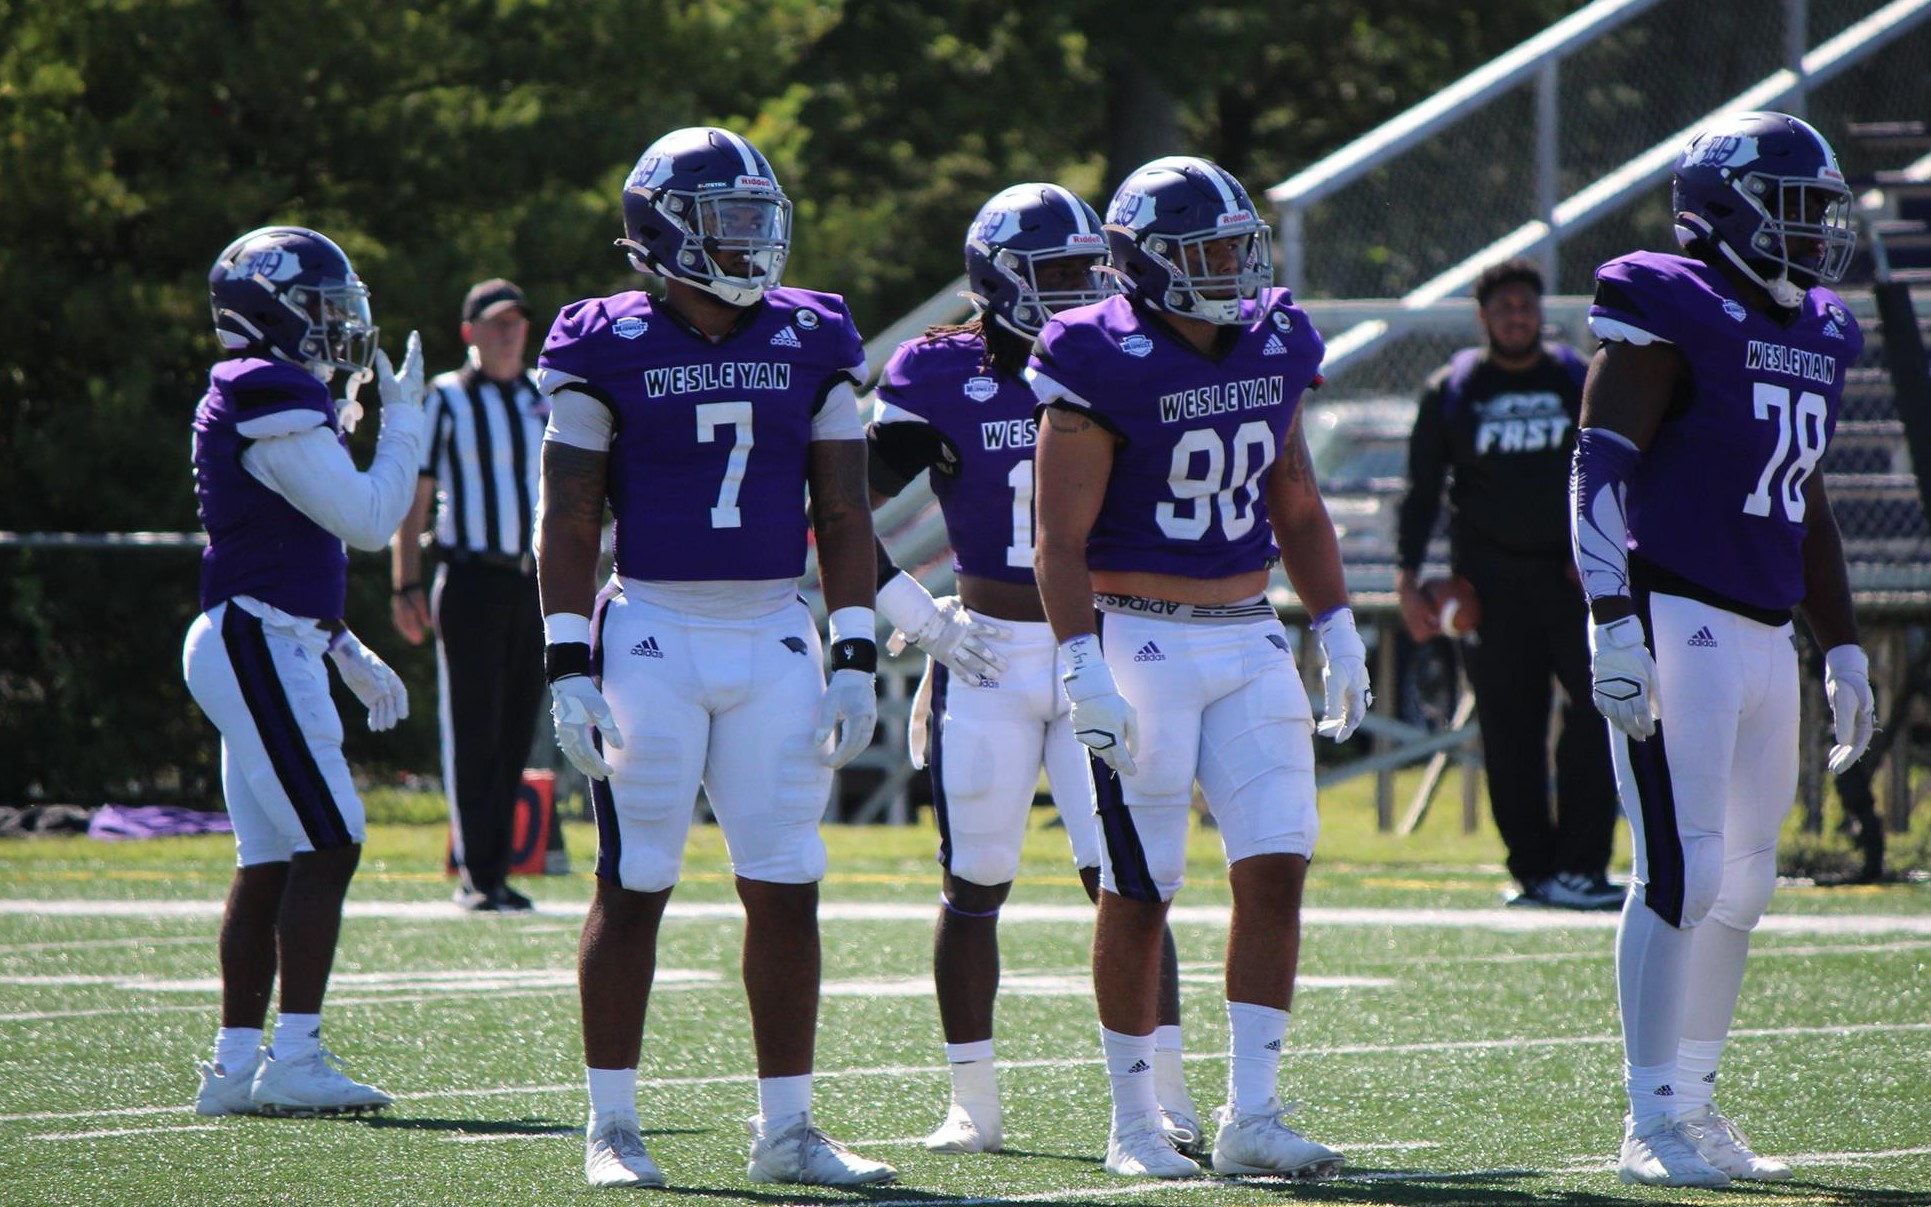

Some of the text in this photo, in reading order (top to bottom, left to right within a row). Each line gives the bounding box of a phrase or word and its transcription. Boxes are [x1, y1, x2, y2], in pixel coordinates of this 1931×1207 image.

[1223, 212, 1250, 223] Riddell
[770, 338, 801, 348] adidas
[1746, 340, 1835, 385] WESLEYAN
[644, 363, 791, 398] WESLEYAN
[1160, 376, 1284, 423] WESLEYAN
[1477, 418, 1571, 453] FAST
[1743, 382, 1828, 523] 78
[696, 401, 755, 529] 7
[1155, 420, 1276, 541] 90
[630, 648, 664, 658] adidas
[1134, 652, 1166, 662] adidas
[1687, 638, 1717, 648] adidas
